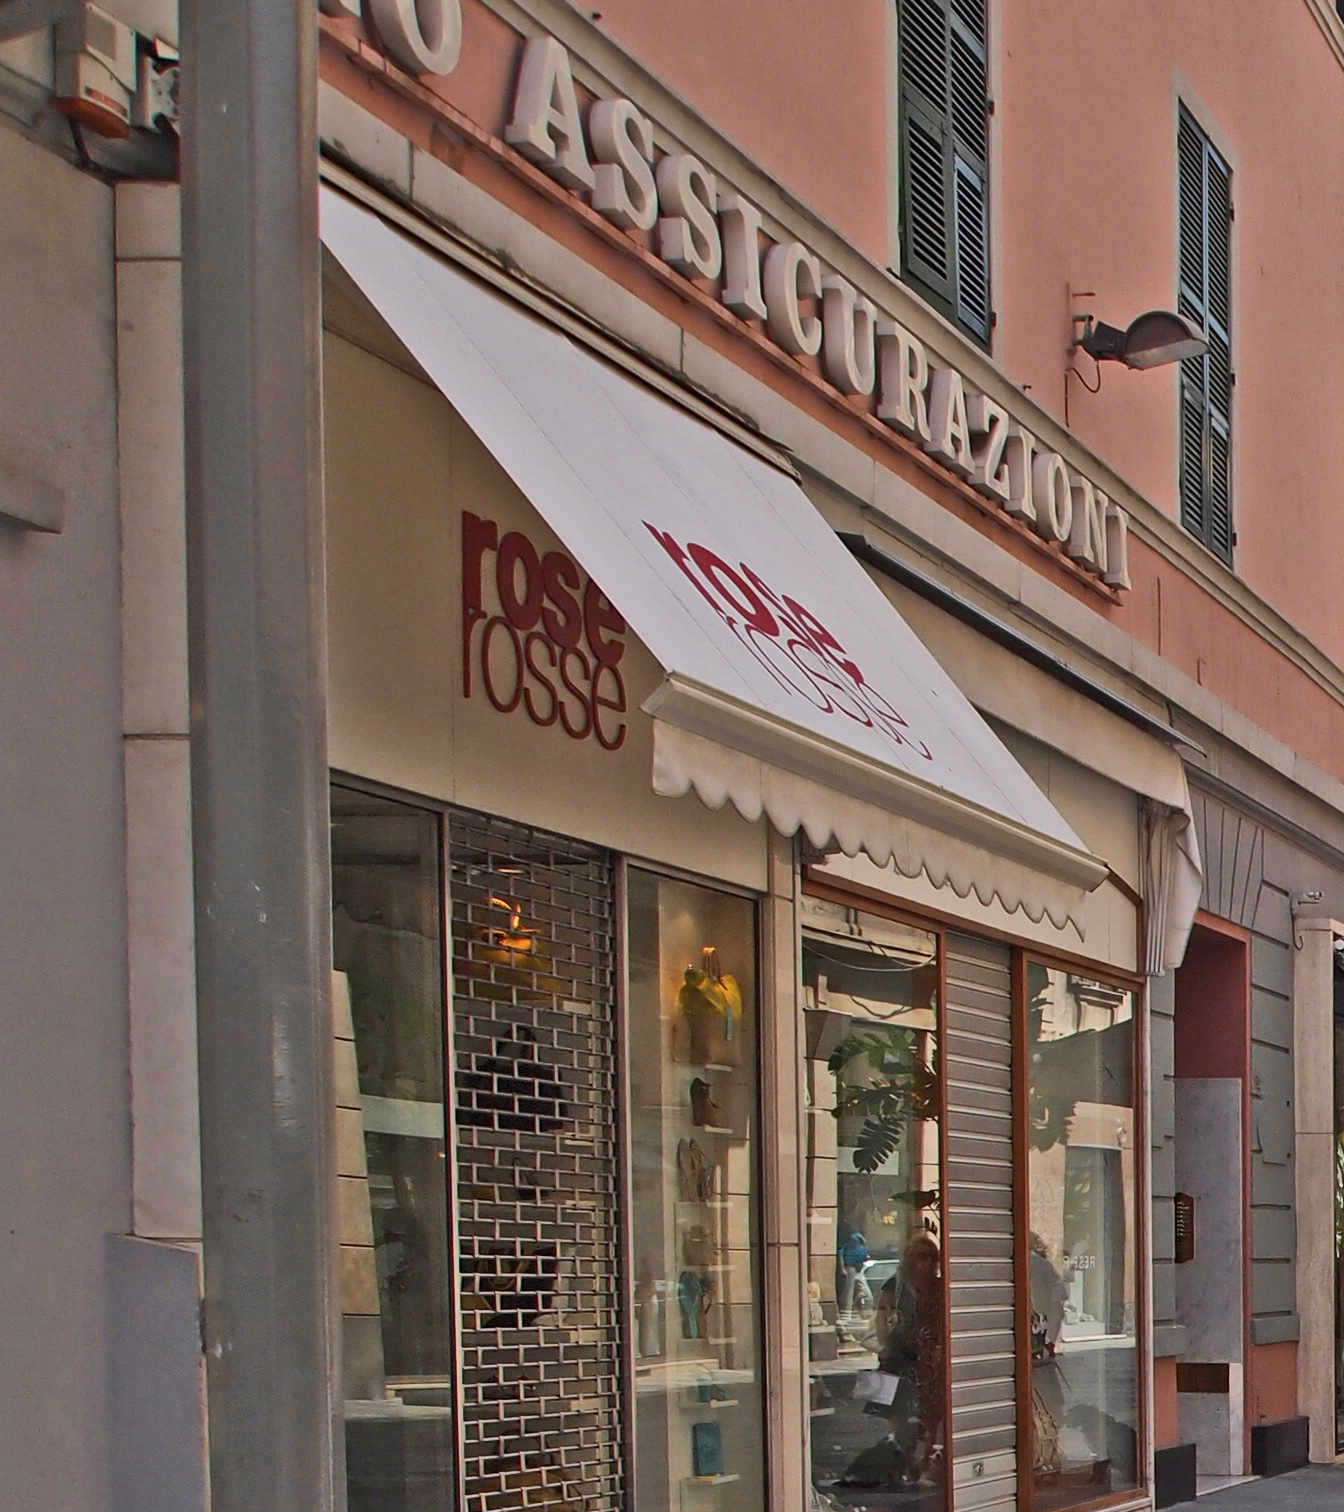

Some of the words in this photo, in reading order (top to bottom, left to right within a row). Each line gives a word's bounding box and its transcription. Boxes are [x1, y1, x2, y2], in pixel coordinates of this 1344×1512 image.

[506, 36, 1131, 591] ASSICURAZIONI
[462, 511, 626, 666] rose
[642, 520, 864, 683] rose
[463, 606, 626, 750] rosse
[715, 609, 932, 760] rosse
